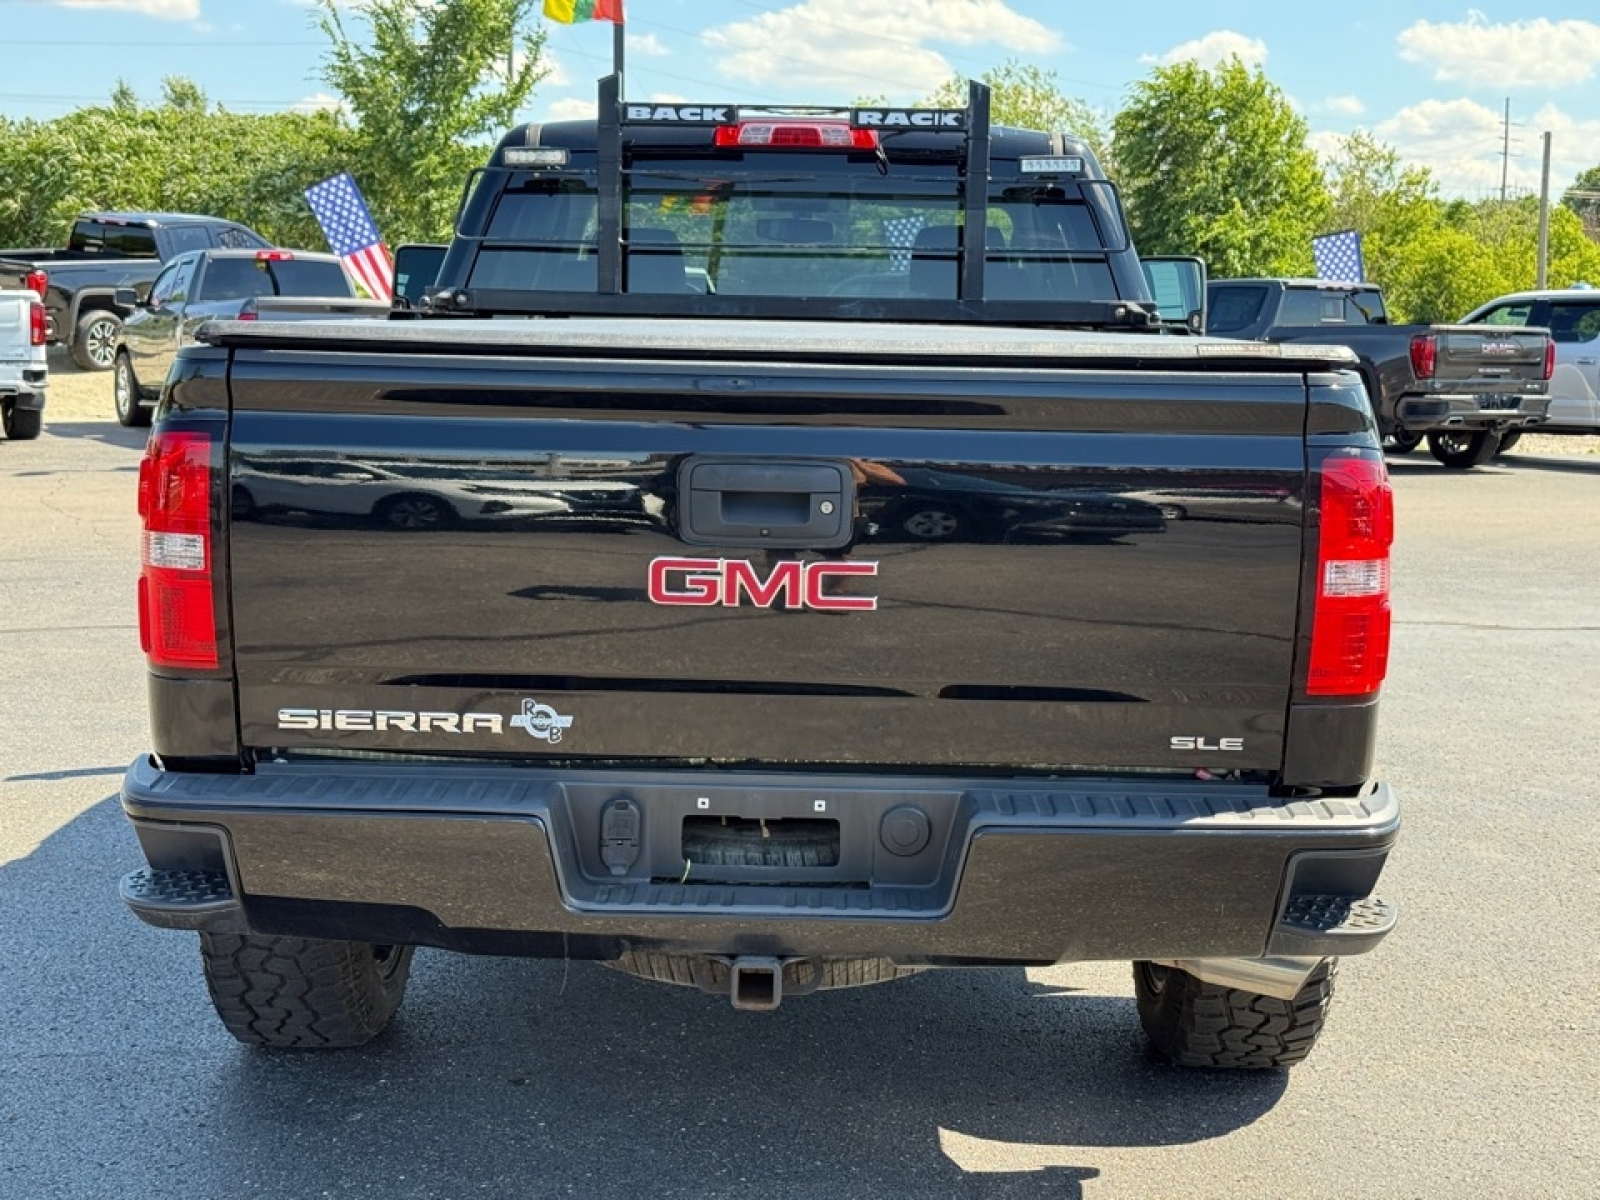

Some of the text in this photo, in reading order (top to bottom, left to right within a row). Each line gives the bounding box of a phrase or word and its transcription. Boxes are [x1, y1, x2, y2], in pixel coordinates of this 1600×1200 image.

[627, 106, 962, 126] BACK RACK
[648, 556, 879, 610] GMC
[277, 708, 503, 734] SIERRA
[1170, 736, 1244, 751] SLE
